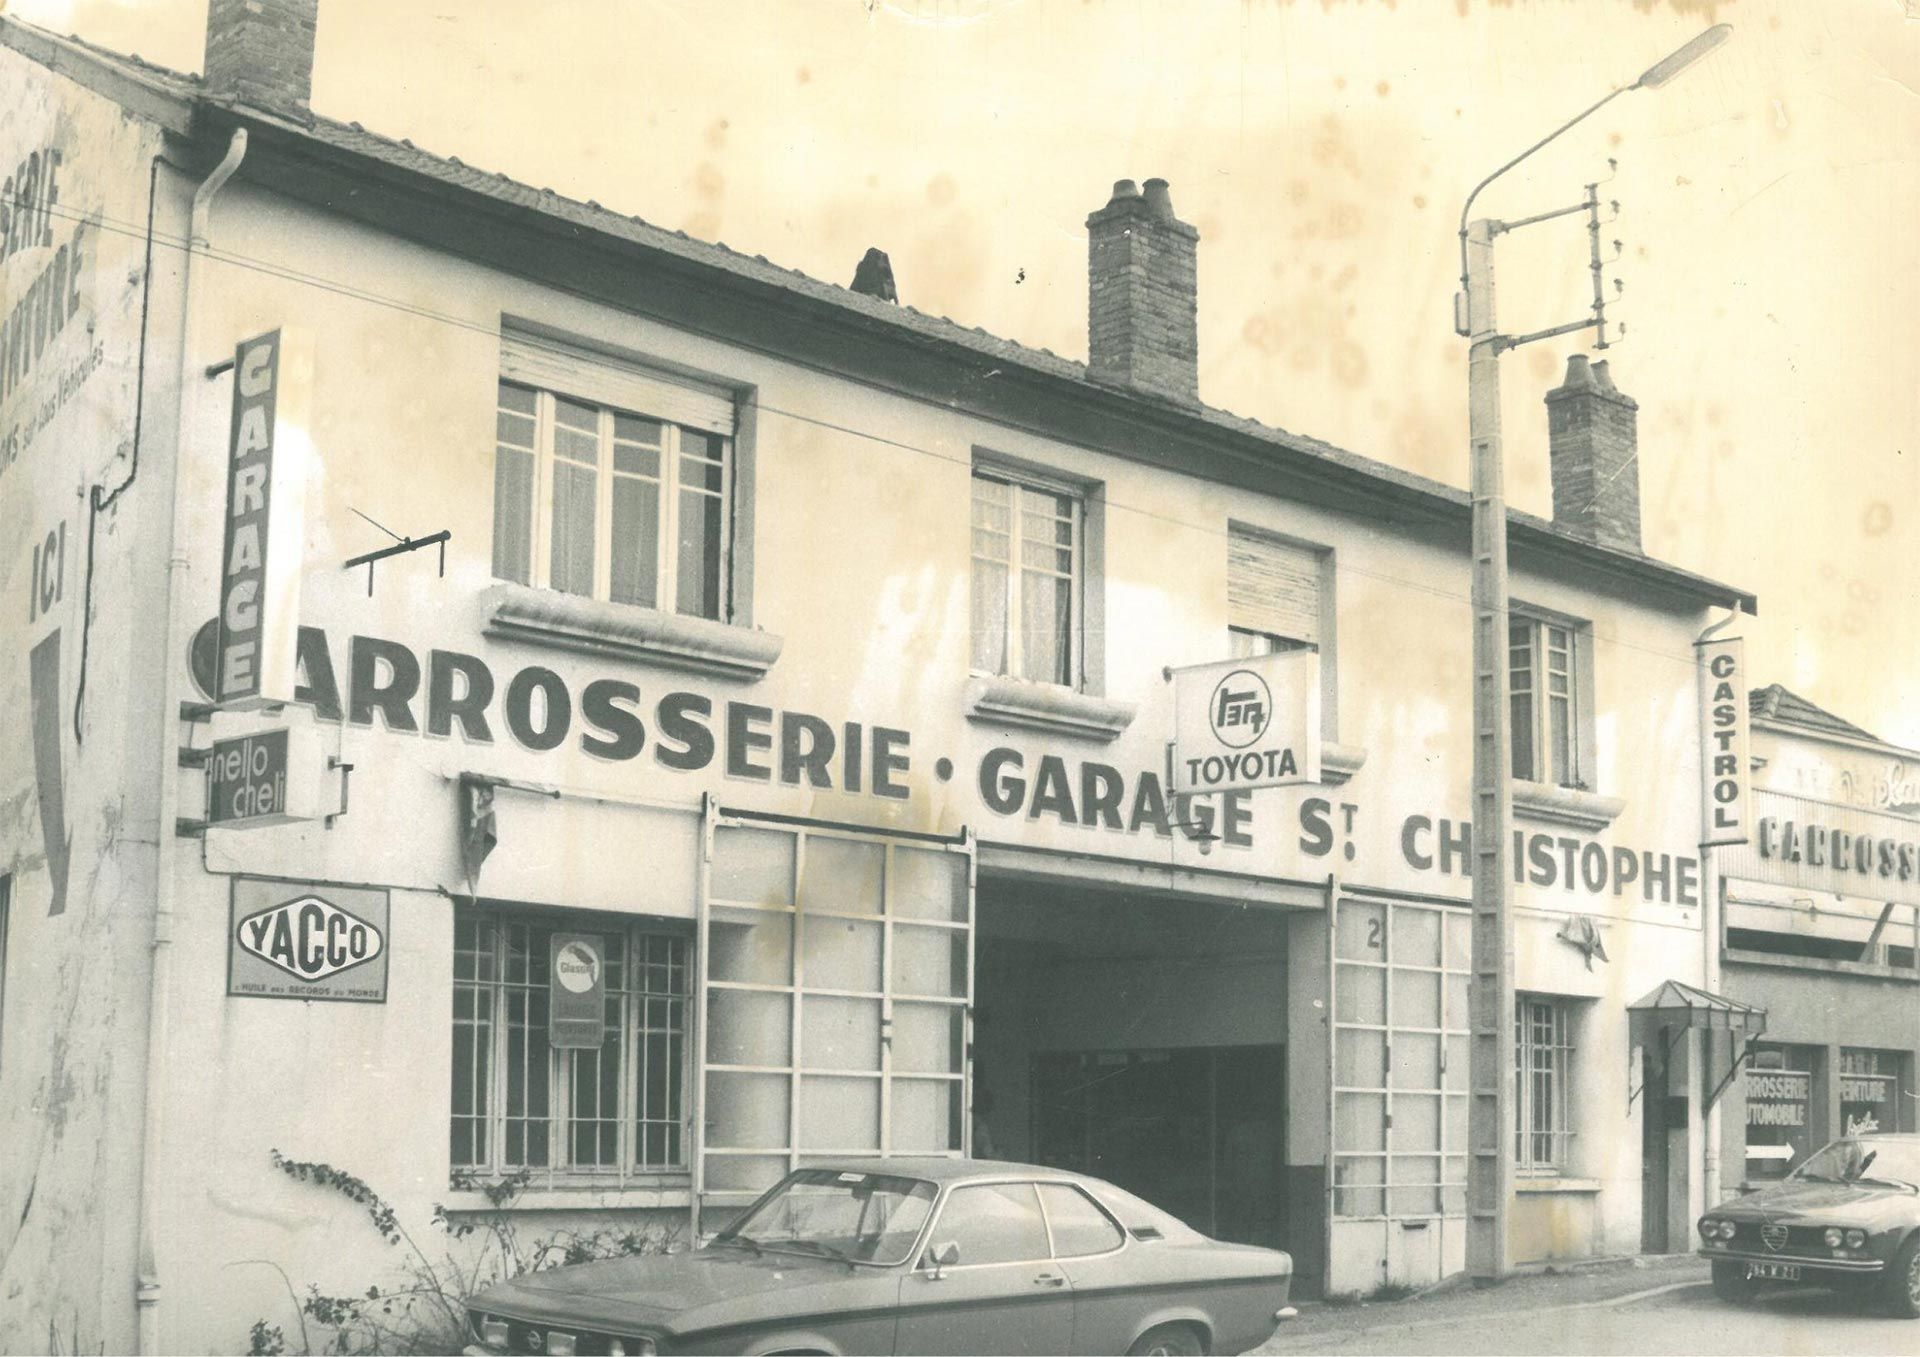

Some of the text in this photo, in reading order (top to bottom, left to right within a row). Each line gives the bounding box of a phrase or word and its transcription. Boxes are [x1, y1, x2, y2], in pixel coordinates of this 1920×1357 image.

[222, 344, 273, 695] GARAGE
[30, 520, 66, 624] ICI
[213, 739, 268, 783] nello
[1186, 748, 1298, 786] TOYOTA
[1711, 655, 1739, 828] CASTROL
[233, 771, 285, 818] cheli
[978, 747, 1254, 849] GARAGE
[1401, 814, 1699, 907] CHISTOPHE
[1759, 815, 1920, 884] CARROSS
[249, 903, 368, 975] YACCO
[1367, 918, 1380, 948] 2
[289, 985, 330, 996] RECORDS
